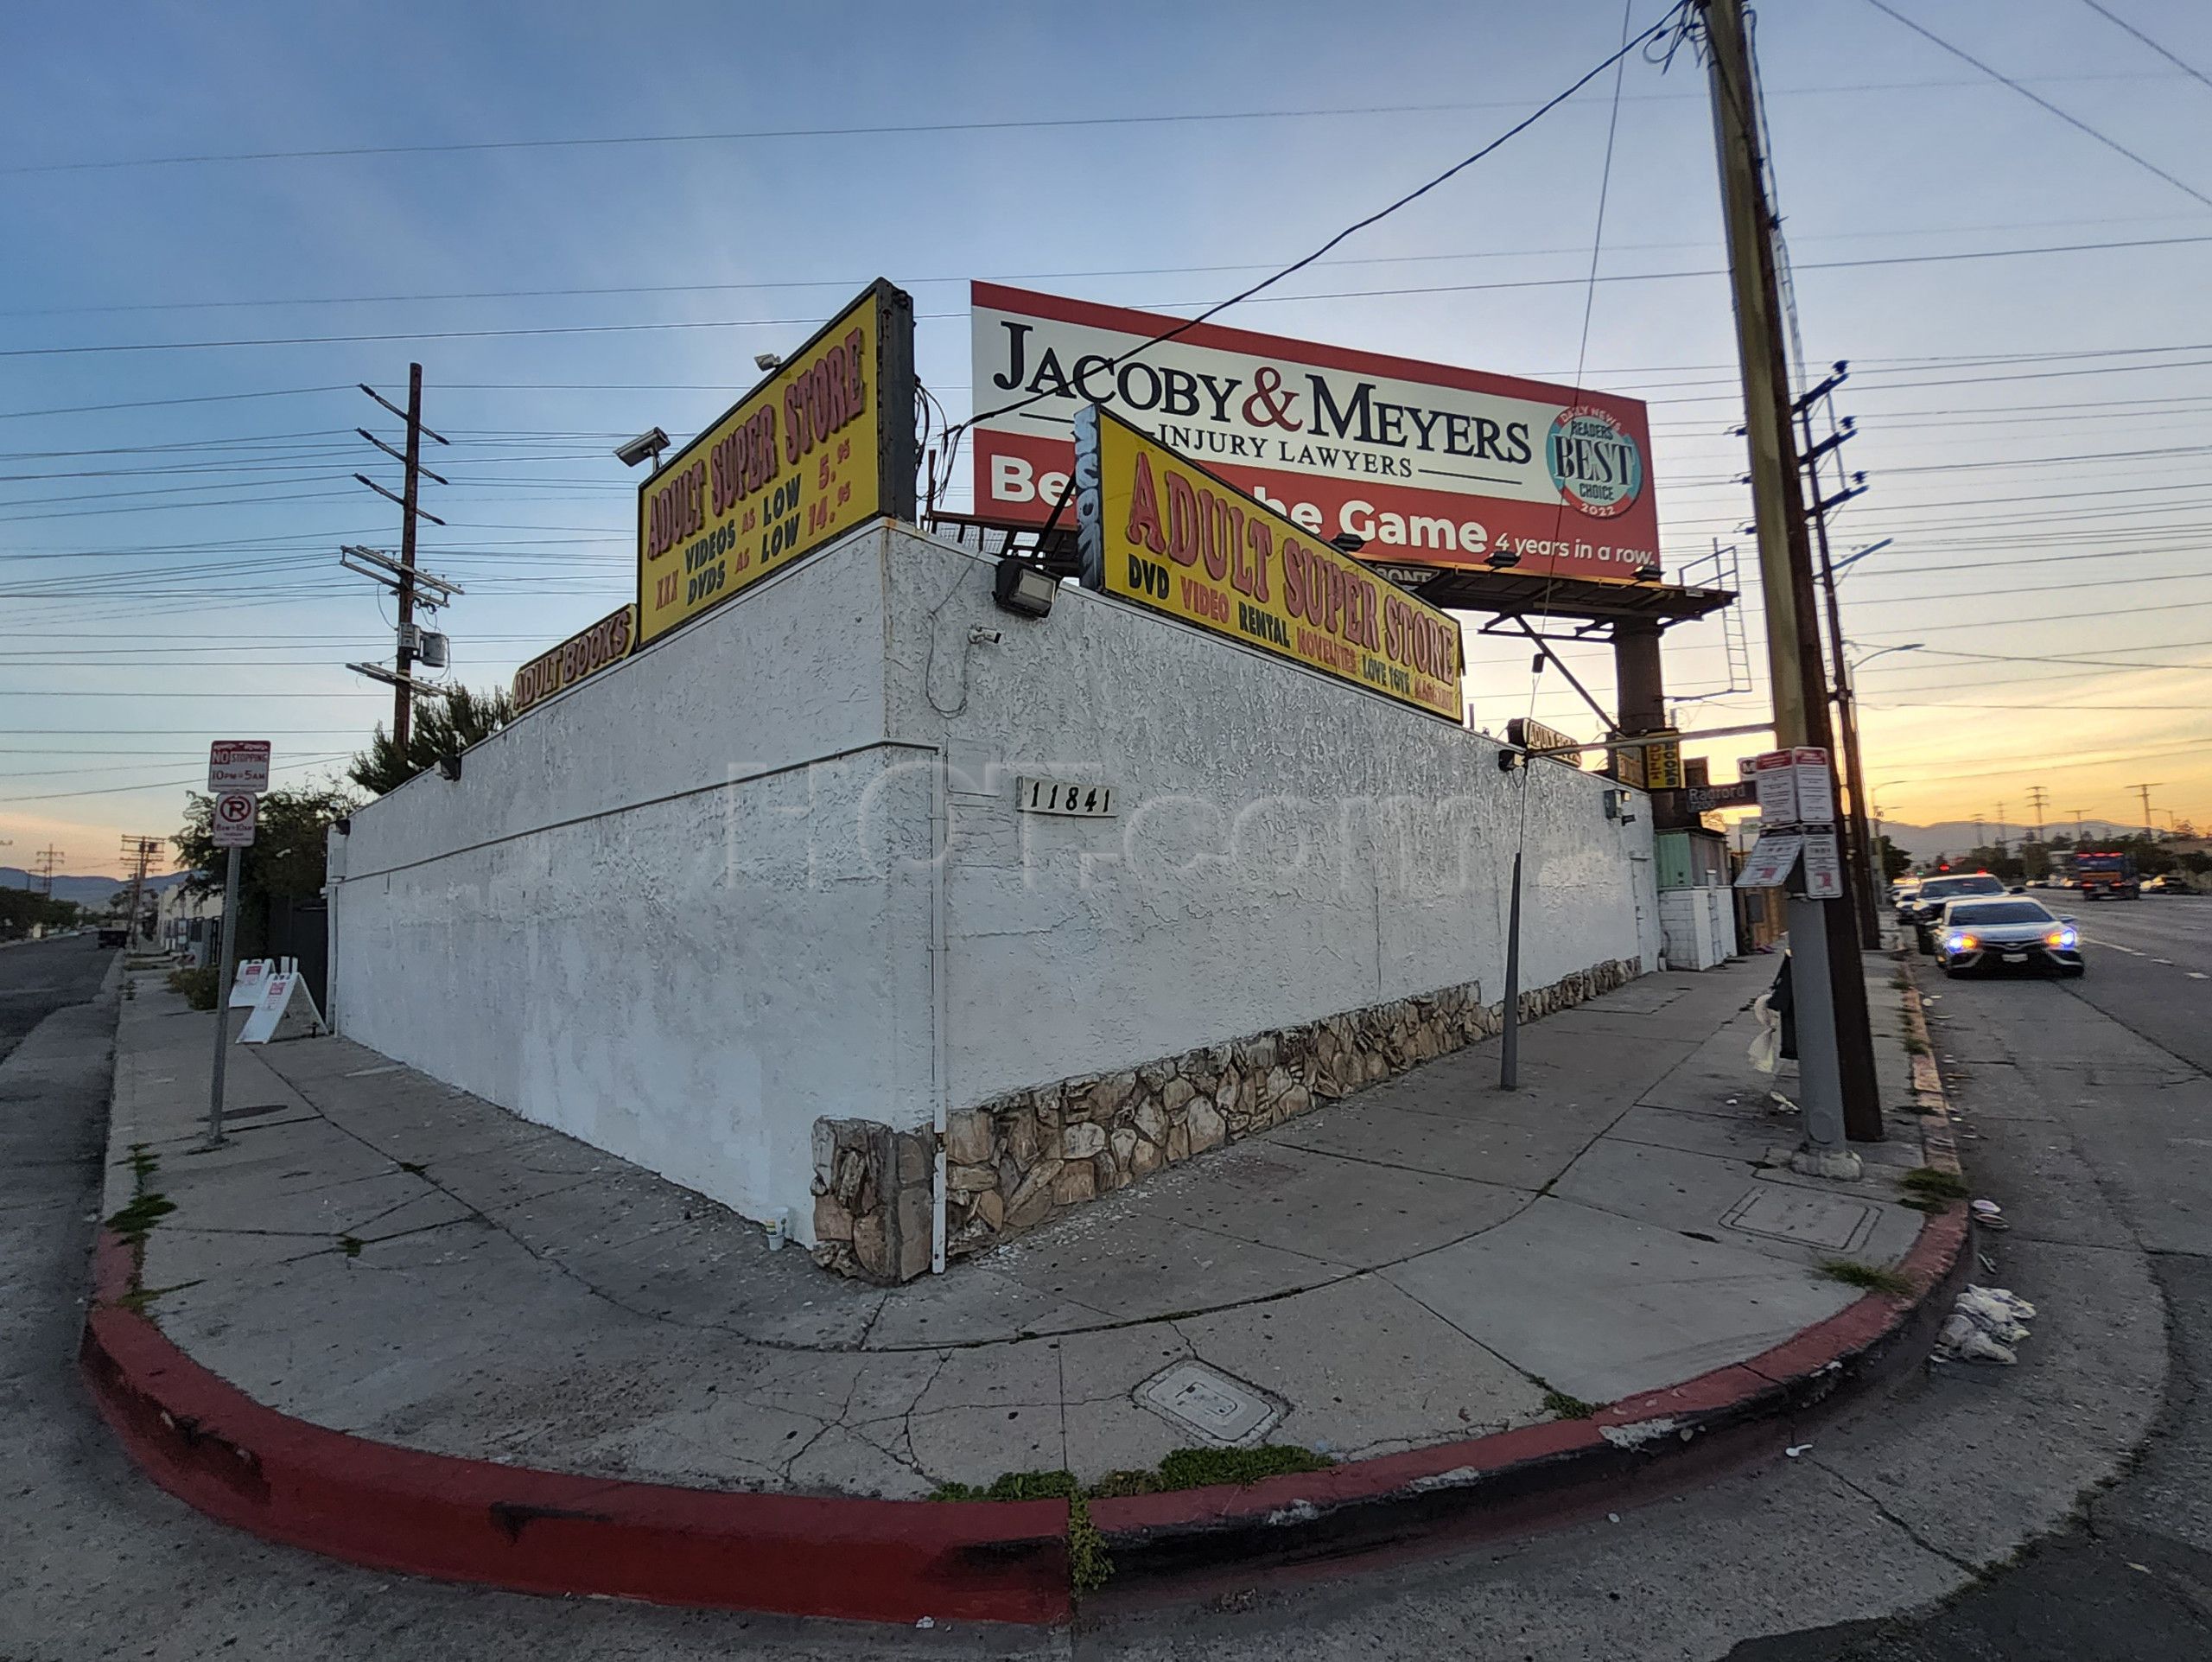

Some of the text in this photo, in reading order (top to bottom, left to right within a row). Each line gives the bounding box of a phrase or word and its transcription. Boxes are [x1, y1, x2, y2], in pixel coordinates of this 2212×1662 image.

[646, 327, 865, 562] ADULT SUPER STORE
[1591, 408, 1622, 431] NEWS
[1157, 423, 1413, 479] INJURY LAWYERS
[1554, 434, 1633, 486] BEST
[1580, 483, 1614, 501] CHOICE
[1580, 503, 1617, 517] 2022
[685, 519, 736, 575] VIDEOS
[741, 507, 756, 535] AS
[763, 474, 802, 528] LOW
[1338, 500, 1488, 554] Game
[1495, 532, 1656, 565] 4 years in a row.
[687, 560, 726, 606] DVDS
[734, 547, 751, 574] AS
[760, 513, 801, 565] LOW
[1126, 451, 1457, 687] ADULT SUPER STORE
[656, 570, 680, 611] XXX
[1128, 553, 1169, 601] DVD
[1180, 576, 1230, 624] VIDEO
[1238, 601, 1292, 649] RENTAL
[1362, 653, 1387, 687] LOVE
[512, 610, 632, 710] ADULT BOOKS
[213, 750, 268, 764] NO STOPPING
[1030, 780, 1112, 814] 11841
[1688, 784, 1746, 801] Radford
